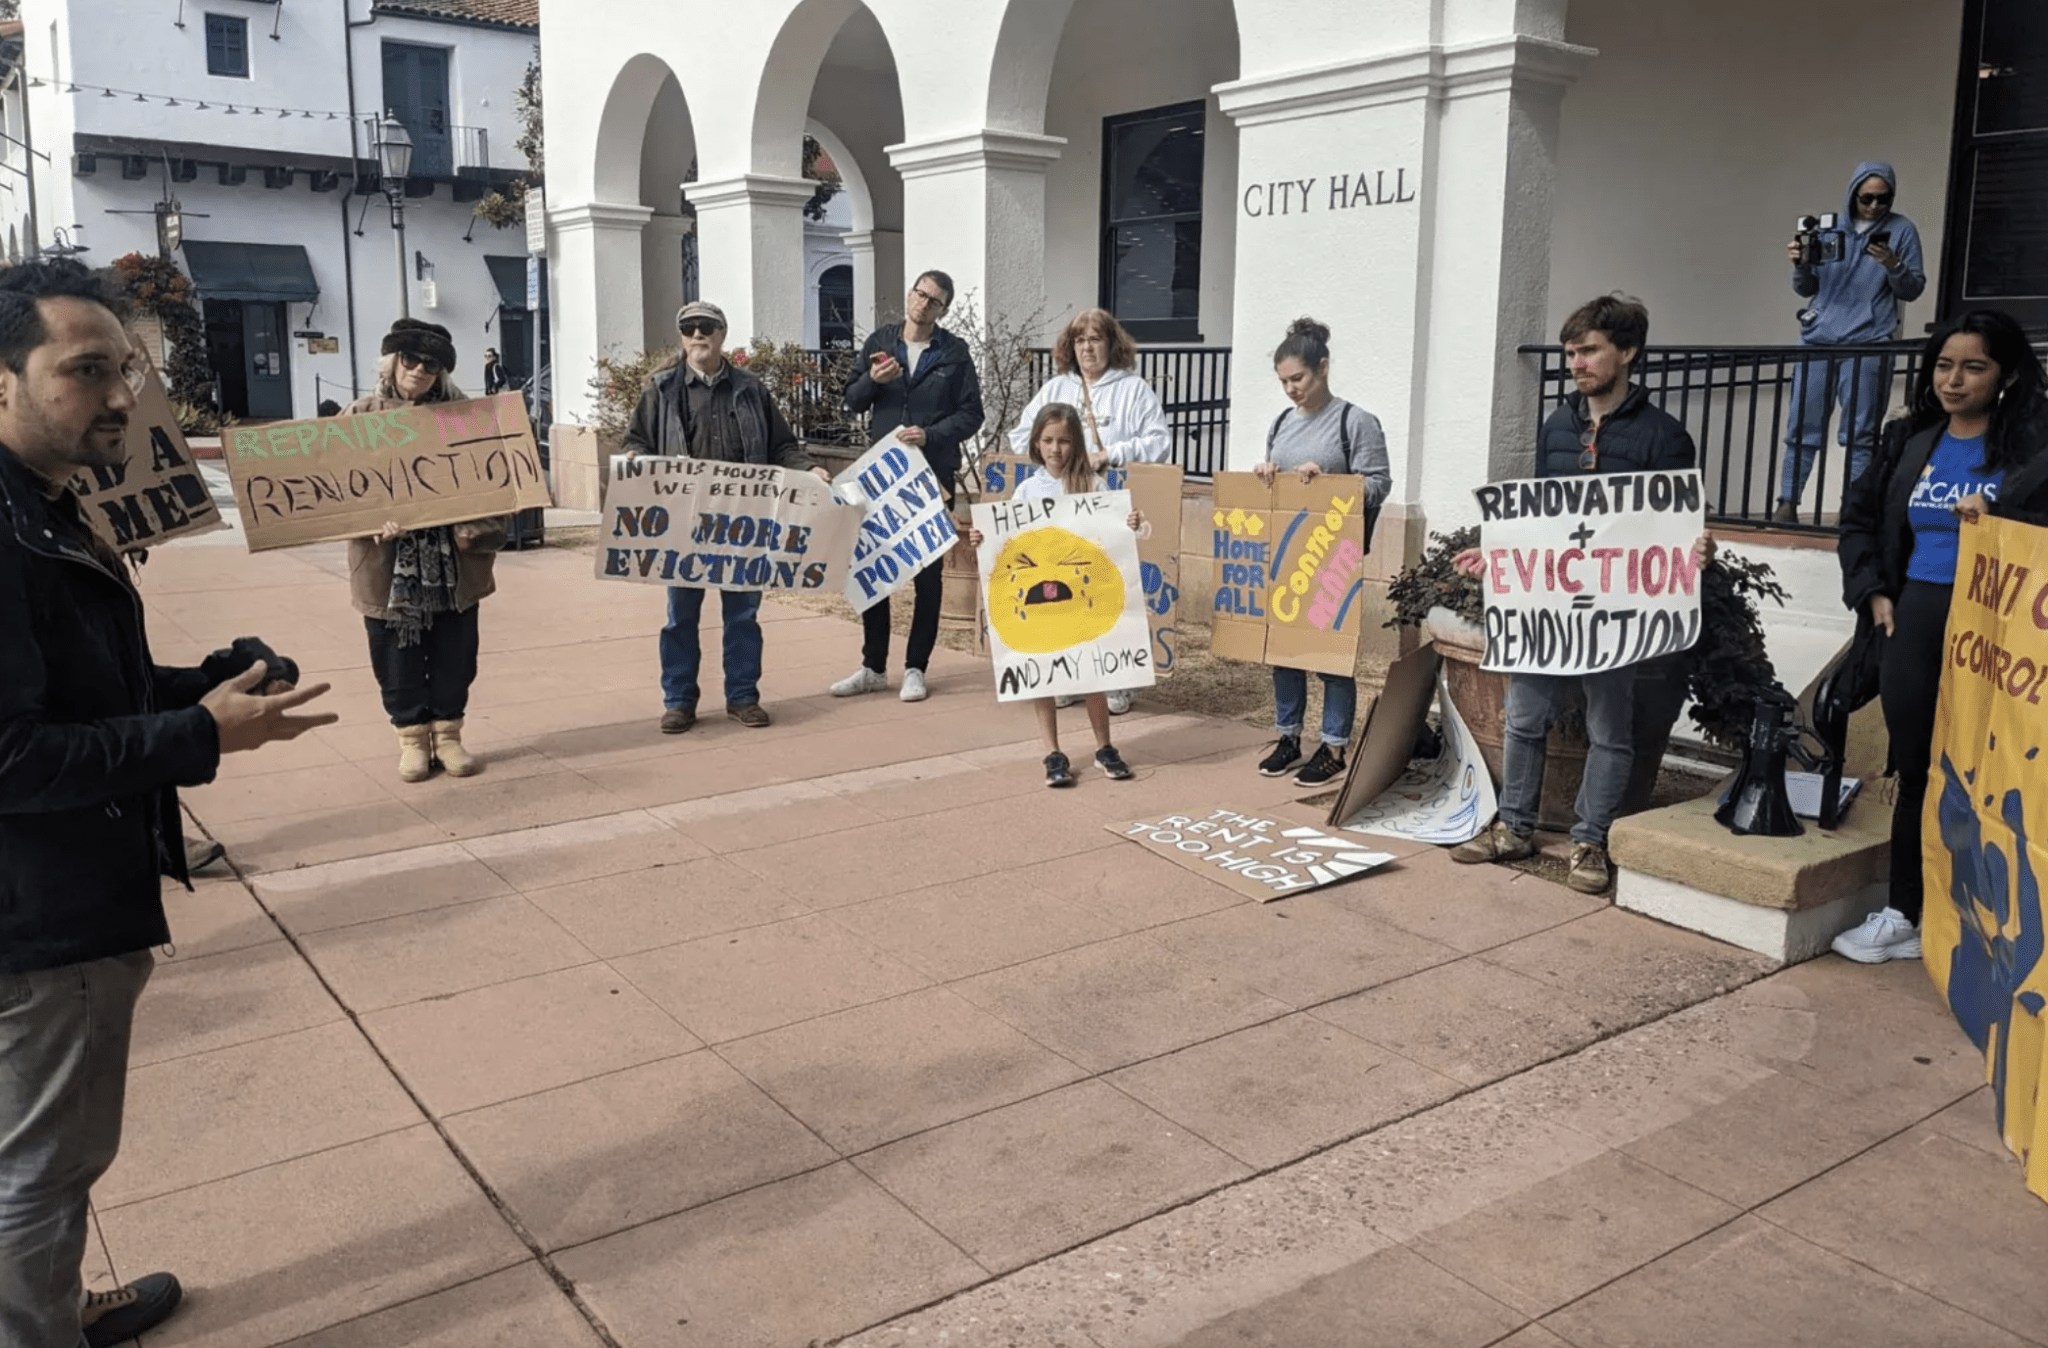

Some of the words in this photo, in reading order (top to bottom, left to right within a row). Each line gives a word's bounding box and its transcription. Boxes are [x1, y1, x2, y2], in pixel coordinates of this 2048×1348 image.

[1244, 178, 1316, 217] CITY
[1328, 168, 1415, 210] HALL
[232, 409, 419, 461] REPAIRS
[432, 394, 520, 445] NOT
[247, 449, 539, 528] RENOVICTION
[617, 460, 643, 481] IN
[649, 461, 708, 476] THIS
[712, 464, 782, 482] HOUSE
[653, 480, 697, 496] WE
[853, 466, 940, 562] ENANT
[992, 497, 1055, 535] HELP
[1074, 497, 1111, 516] ME
[1476, 473, 1701, 522] RENOVATION
[612, 505, 670, 538] NO
[691, 512, 812, 554] MORE
[604, 547, 828, 589] EVICTIONS
[1222, 563, 1265, 589] FOR
[1490, 545, 1702, 597] EVICTION
[1214, 585, 1265, 617] ALL
[1482, 605, 1700, 670] RENOVICTION
[1000, 658, 1041, 695] AND
[1047, 648, 1083, 685] MY
[1157, 814, 1275, 849] RENT
[1269, 847, 1324, 865] IS
[1208, 808, 1277, 832] THE
[1125, 821, 1213, 854] TOO
[1202, 849, 1316, 892] HIGH
